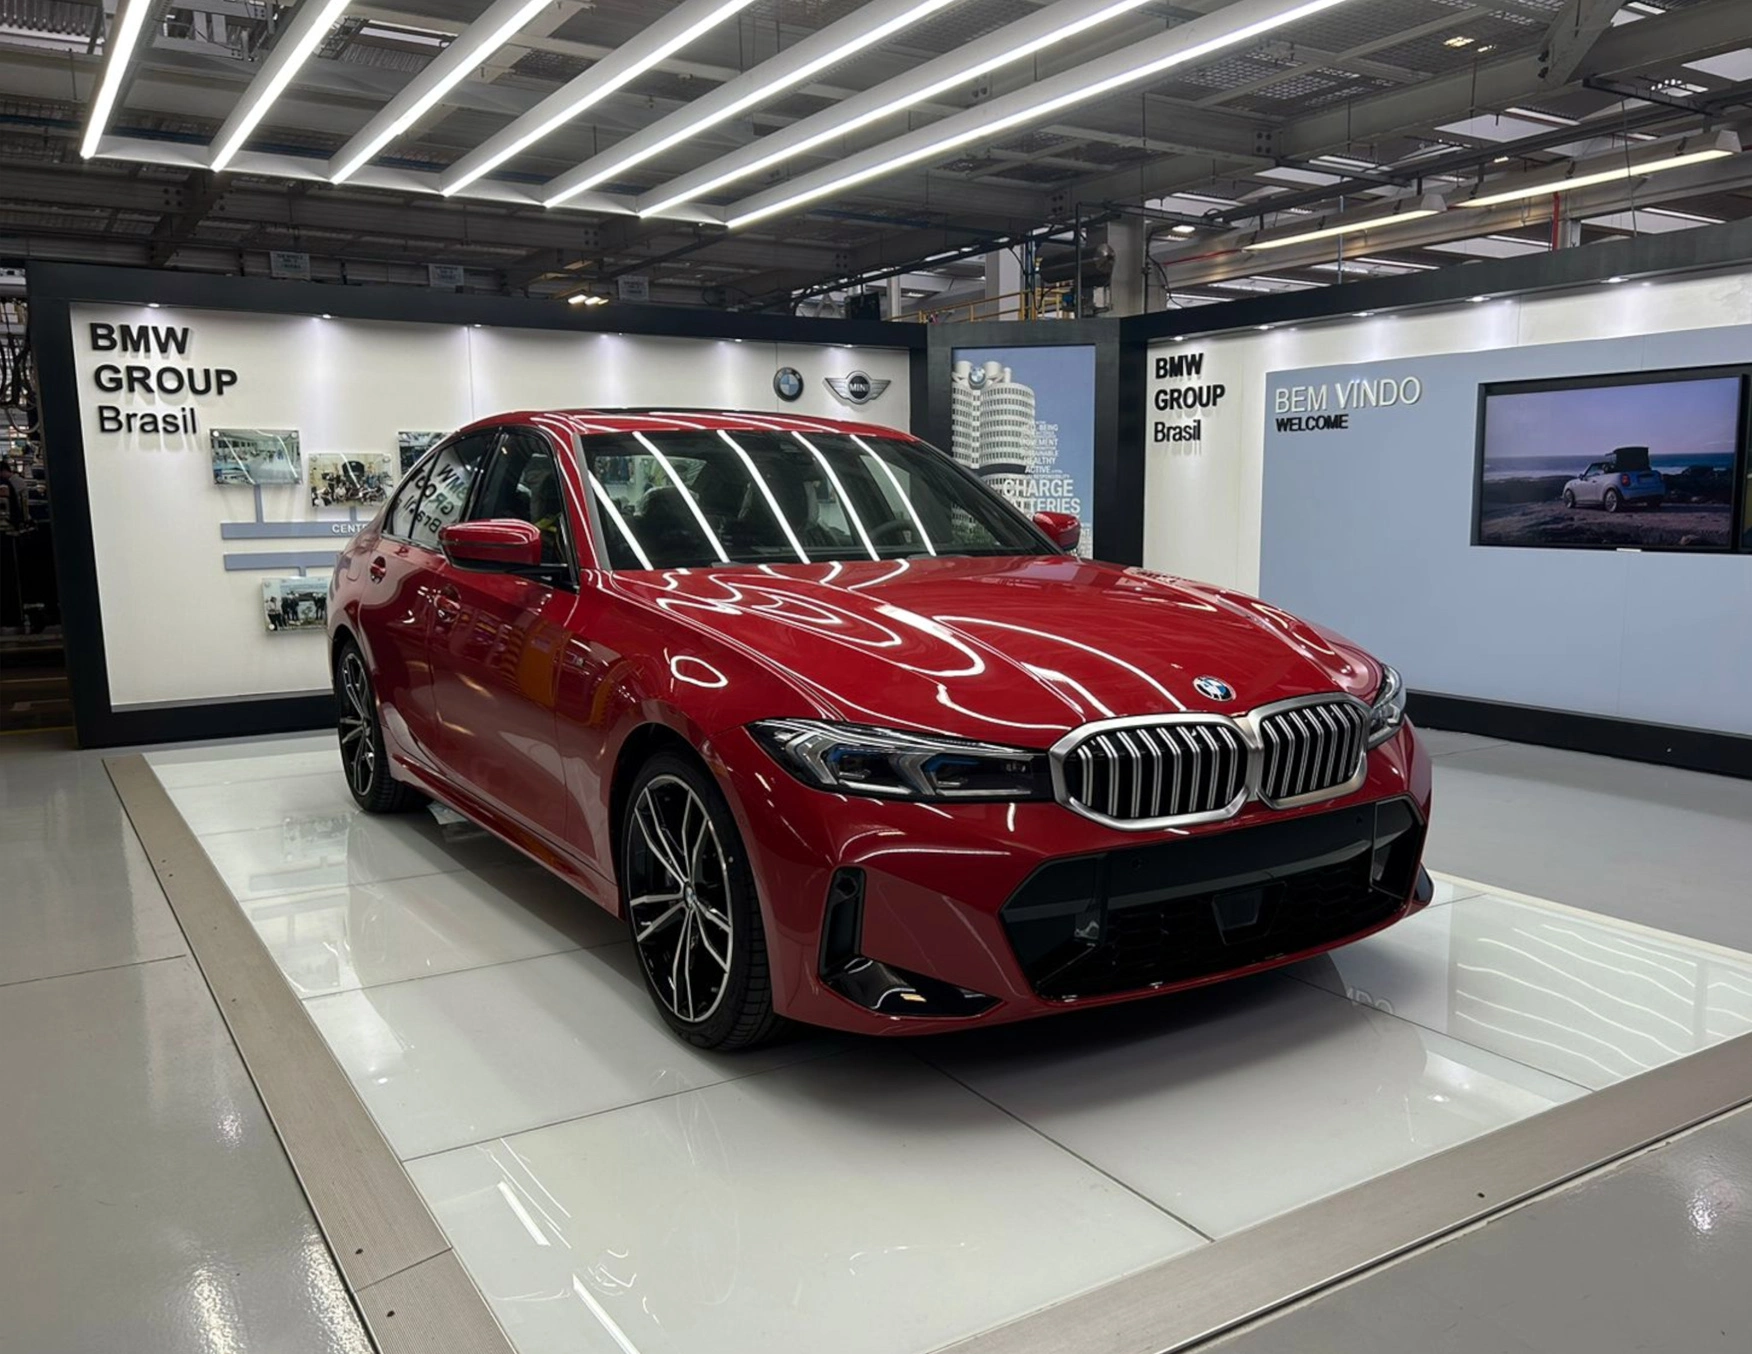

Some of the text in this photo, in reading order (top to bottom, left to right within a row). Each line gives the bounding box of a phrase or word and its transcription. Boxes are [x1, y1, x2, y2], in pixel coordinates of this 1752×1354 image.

[90, 322, 189, 354] BMW
[1155, 353, 1204, 379] BMW
[94, 364, 238, 396] GROUP
[1154, 384, 1225, 411] GROUP
[1275, 376, 1421, 413] BEM VINDO
[98, 405, 197, 434] Brasil
[1154, 419, 1201, 442] Brasil
[1276, 414, 1349, 432] WELCOME
[1025, 465, 1051, 474] ACTIVE
[1003, 479, 1074, 497] CHARGE
[1012, 498, 1081, 513] ATTERIES
